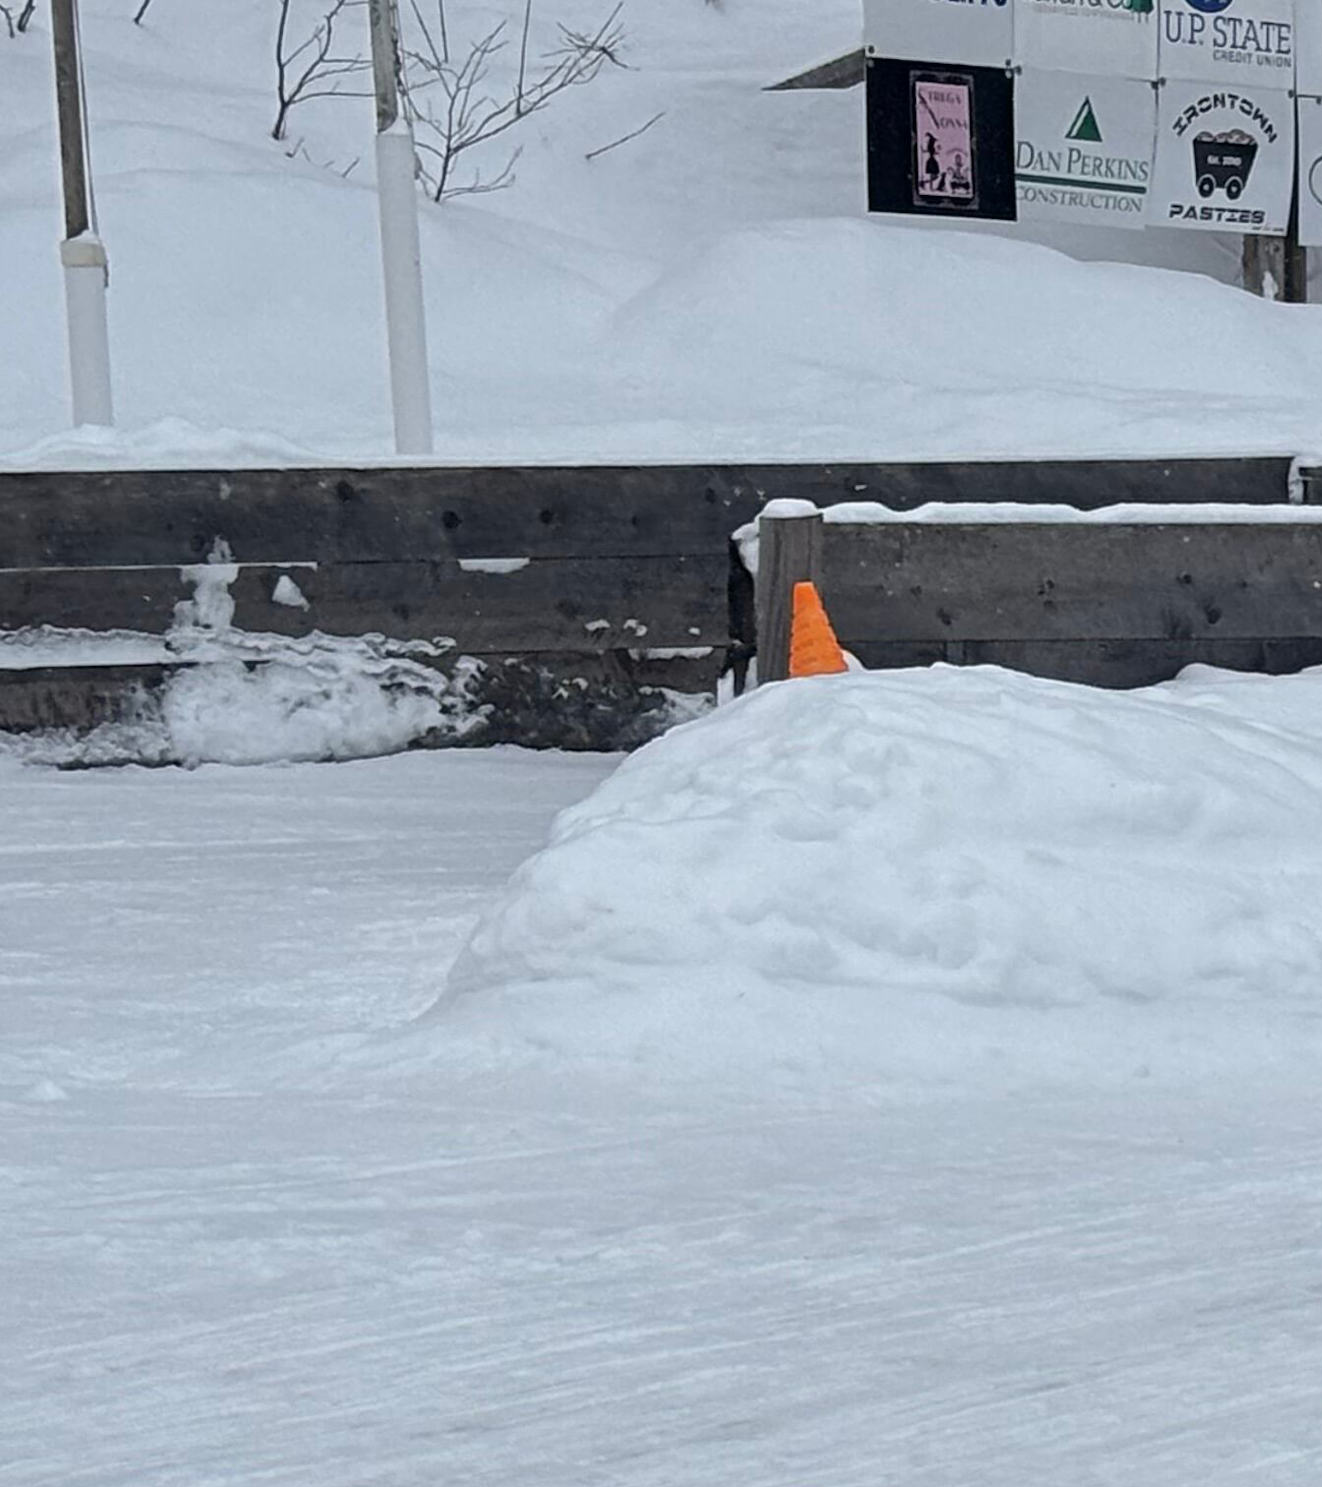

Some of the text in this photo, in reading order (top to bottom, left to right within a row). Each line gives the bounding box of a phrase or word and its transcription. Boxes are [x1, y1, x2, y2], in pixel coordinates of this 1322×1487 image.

[1163, 10, 1204, 45] U.P.
[1213, 16, 1291, 54] STATE
[1213, 50, 1292, 68] CREDIT UNION
[1172, 93, 1277, 143] IRONTOWN
[1067, 147, 1150, 181] PERKINS
[1016, 185, 1142, 212] CONSTRUCTION
[1169, 204, 1265, 223] PASTIES
